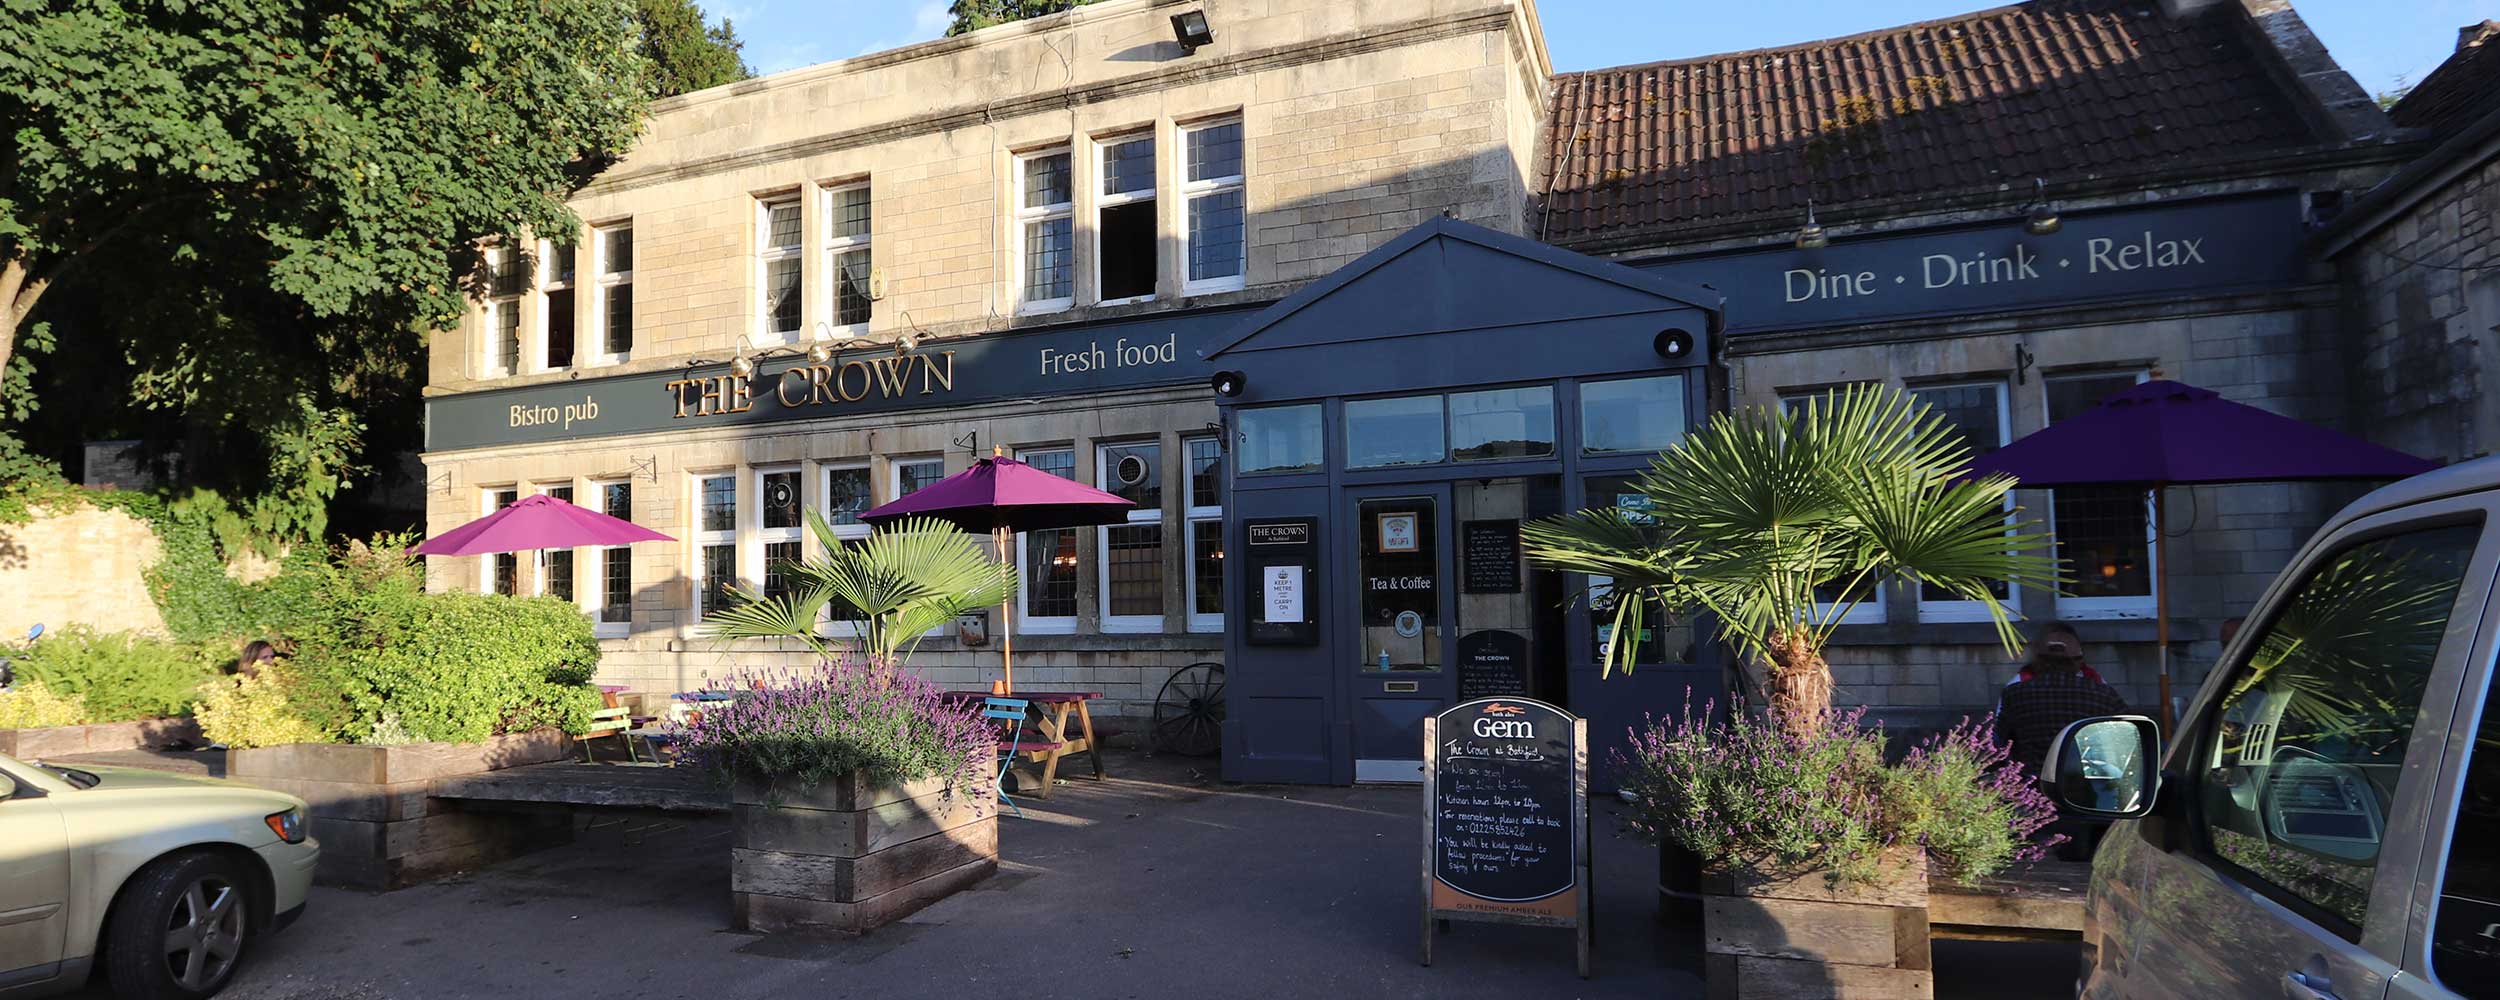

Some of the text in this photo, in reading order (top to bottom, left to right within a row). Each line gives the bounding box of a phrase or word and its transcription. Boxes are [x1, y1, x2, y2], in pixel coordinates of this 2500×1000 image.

[1784, 231, 2205, 302] Dine Drink Relax
[1040, 333, 1176, 375] Fresh food
[667, 350, 956, 418] THE CROWN
[509, 396, 599, 430] Bistro pub
[1252, 526, 1305, 537] THE CROWN
[1370, 576, 1431, 590] Tea & Coffee
[1473, 718, 1535, 739] Gem
[1445, 739, 1462, 756] The
[1466, 741, 1490, 756] Crown
[1495, 745, 1504, 755] at
[1446, 793, 1470, 806] Kitchen
[1522, 814, 1535, 825] call
[1536, 816, 1544, 826] to
[1444, 836, 1459, 848] You
[1462, 838, 1478, 848] will
[1480, 838, 1489, 849] be
[1510, 850, 1520, 867] for
[1476, 904, 1509, 912] PREMIUM
[1510, 906, 1537, 914] AMBER
